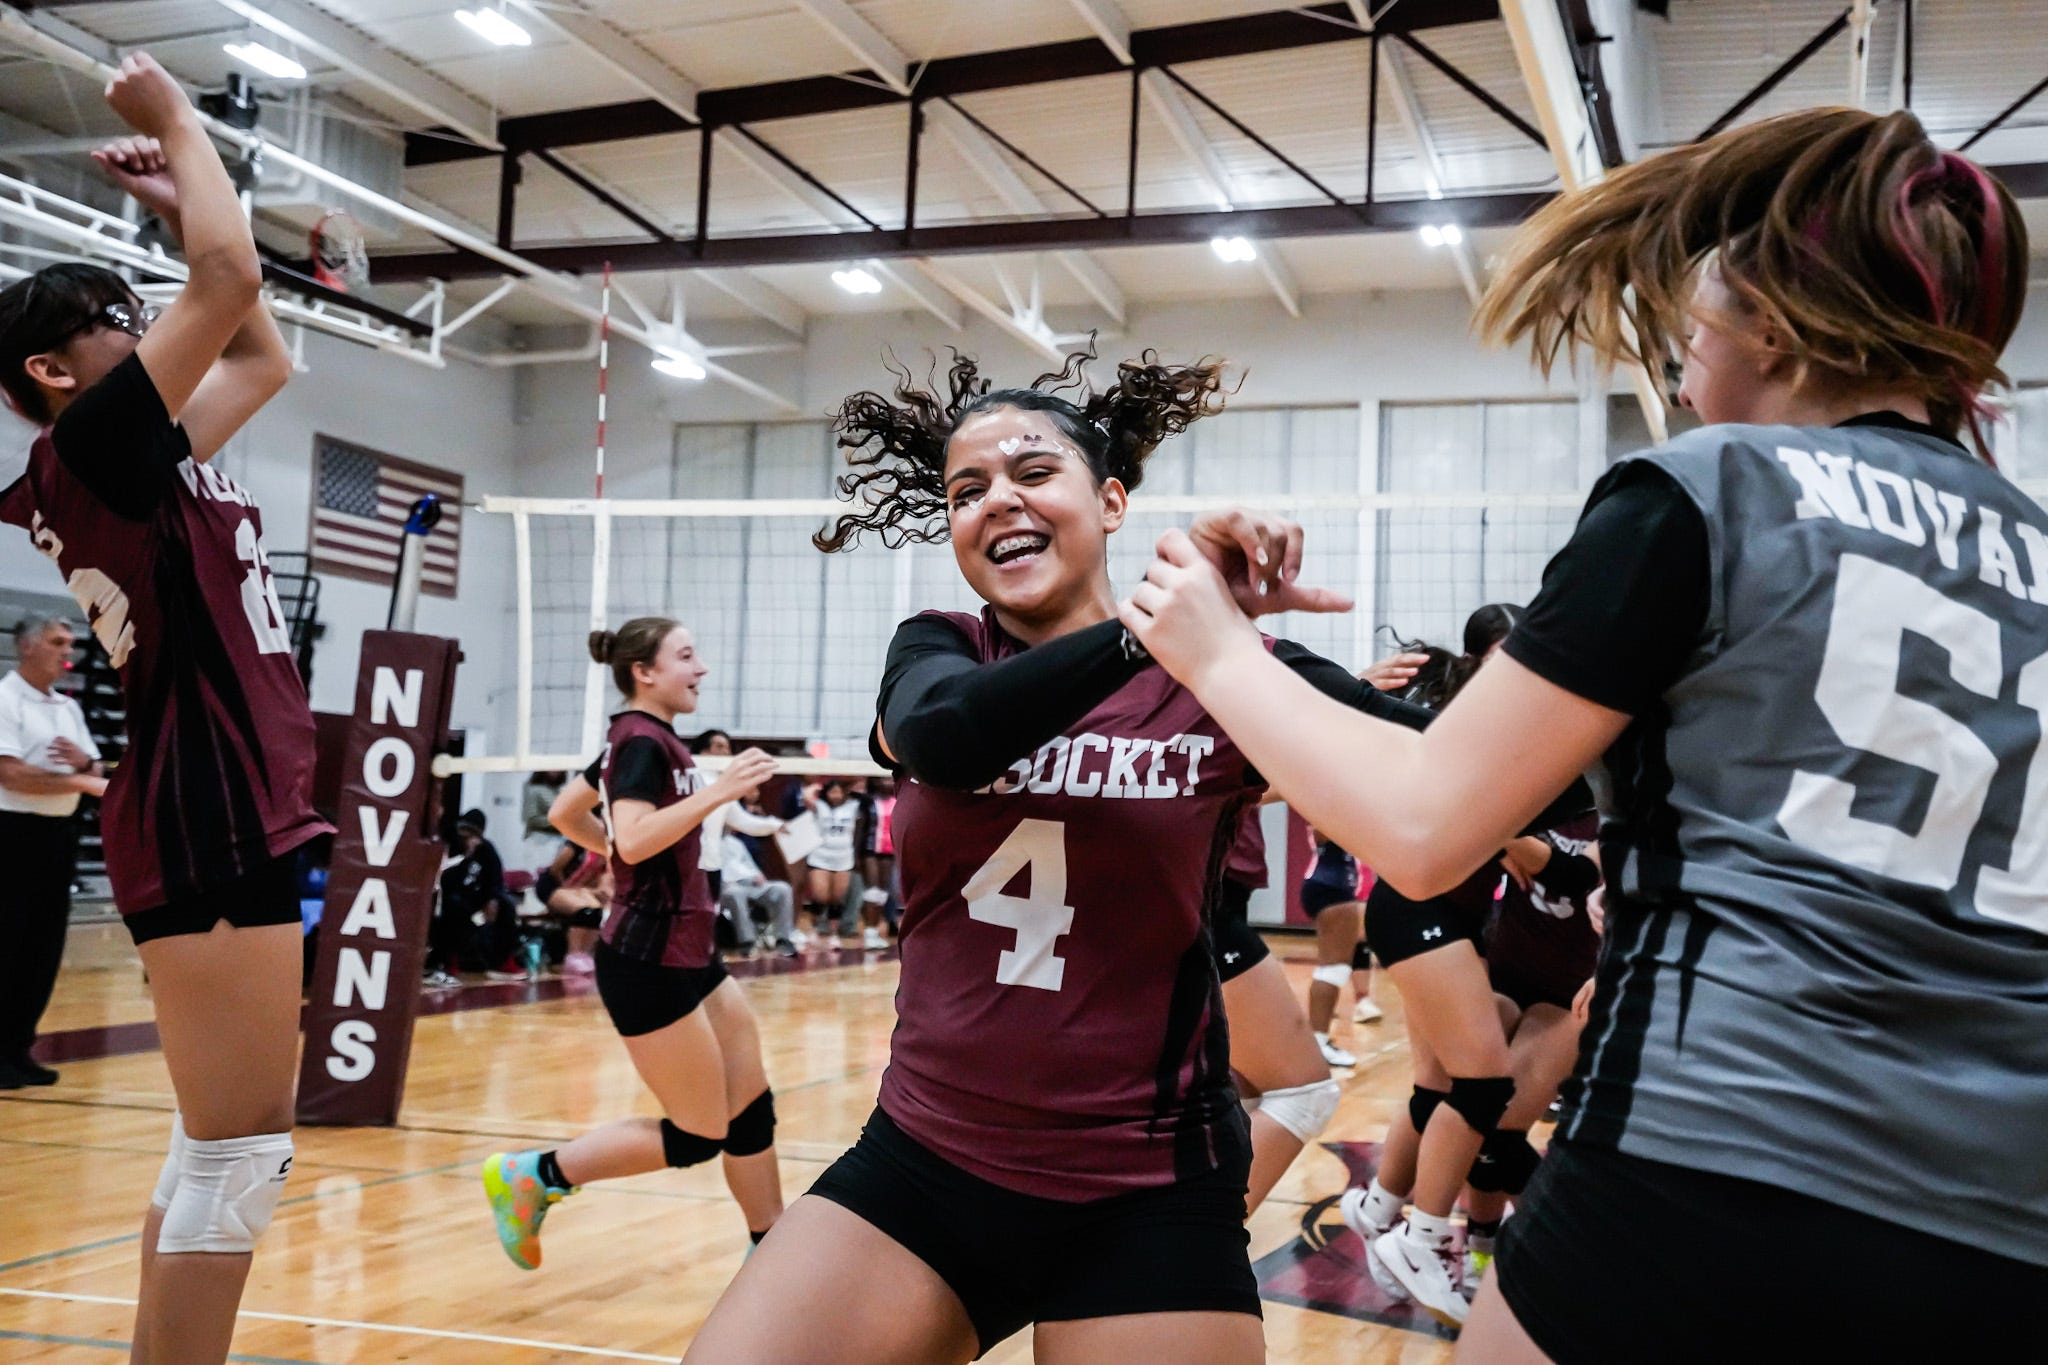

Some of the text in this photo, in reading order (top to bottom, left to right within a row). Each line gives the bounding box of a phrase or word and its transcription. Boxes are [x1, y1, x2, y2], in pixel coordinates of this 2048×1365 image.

[972, 732, 1215, 799] SOCKET
[325, 666, 423, 1082] NOVANS
[961, 818, 1075, 992] 4
